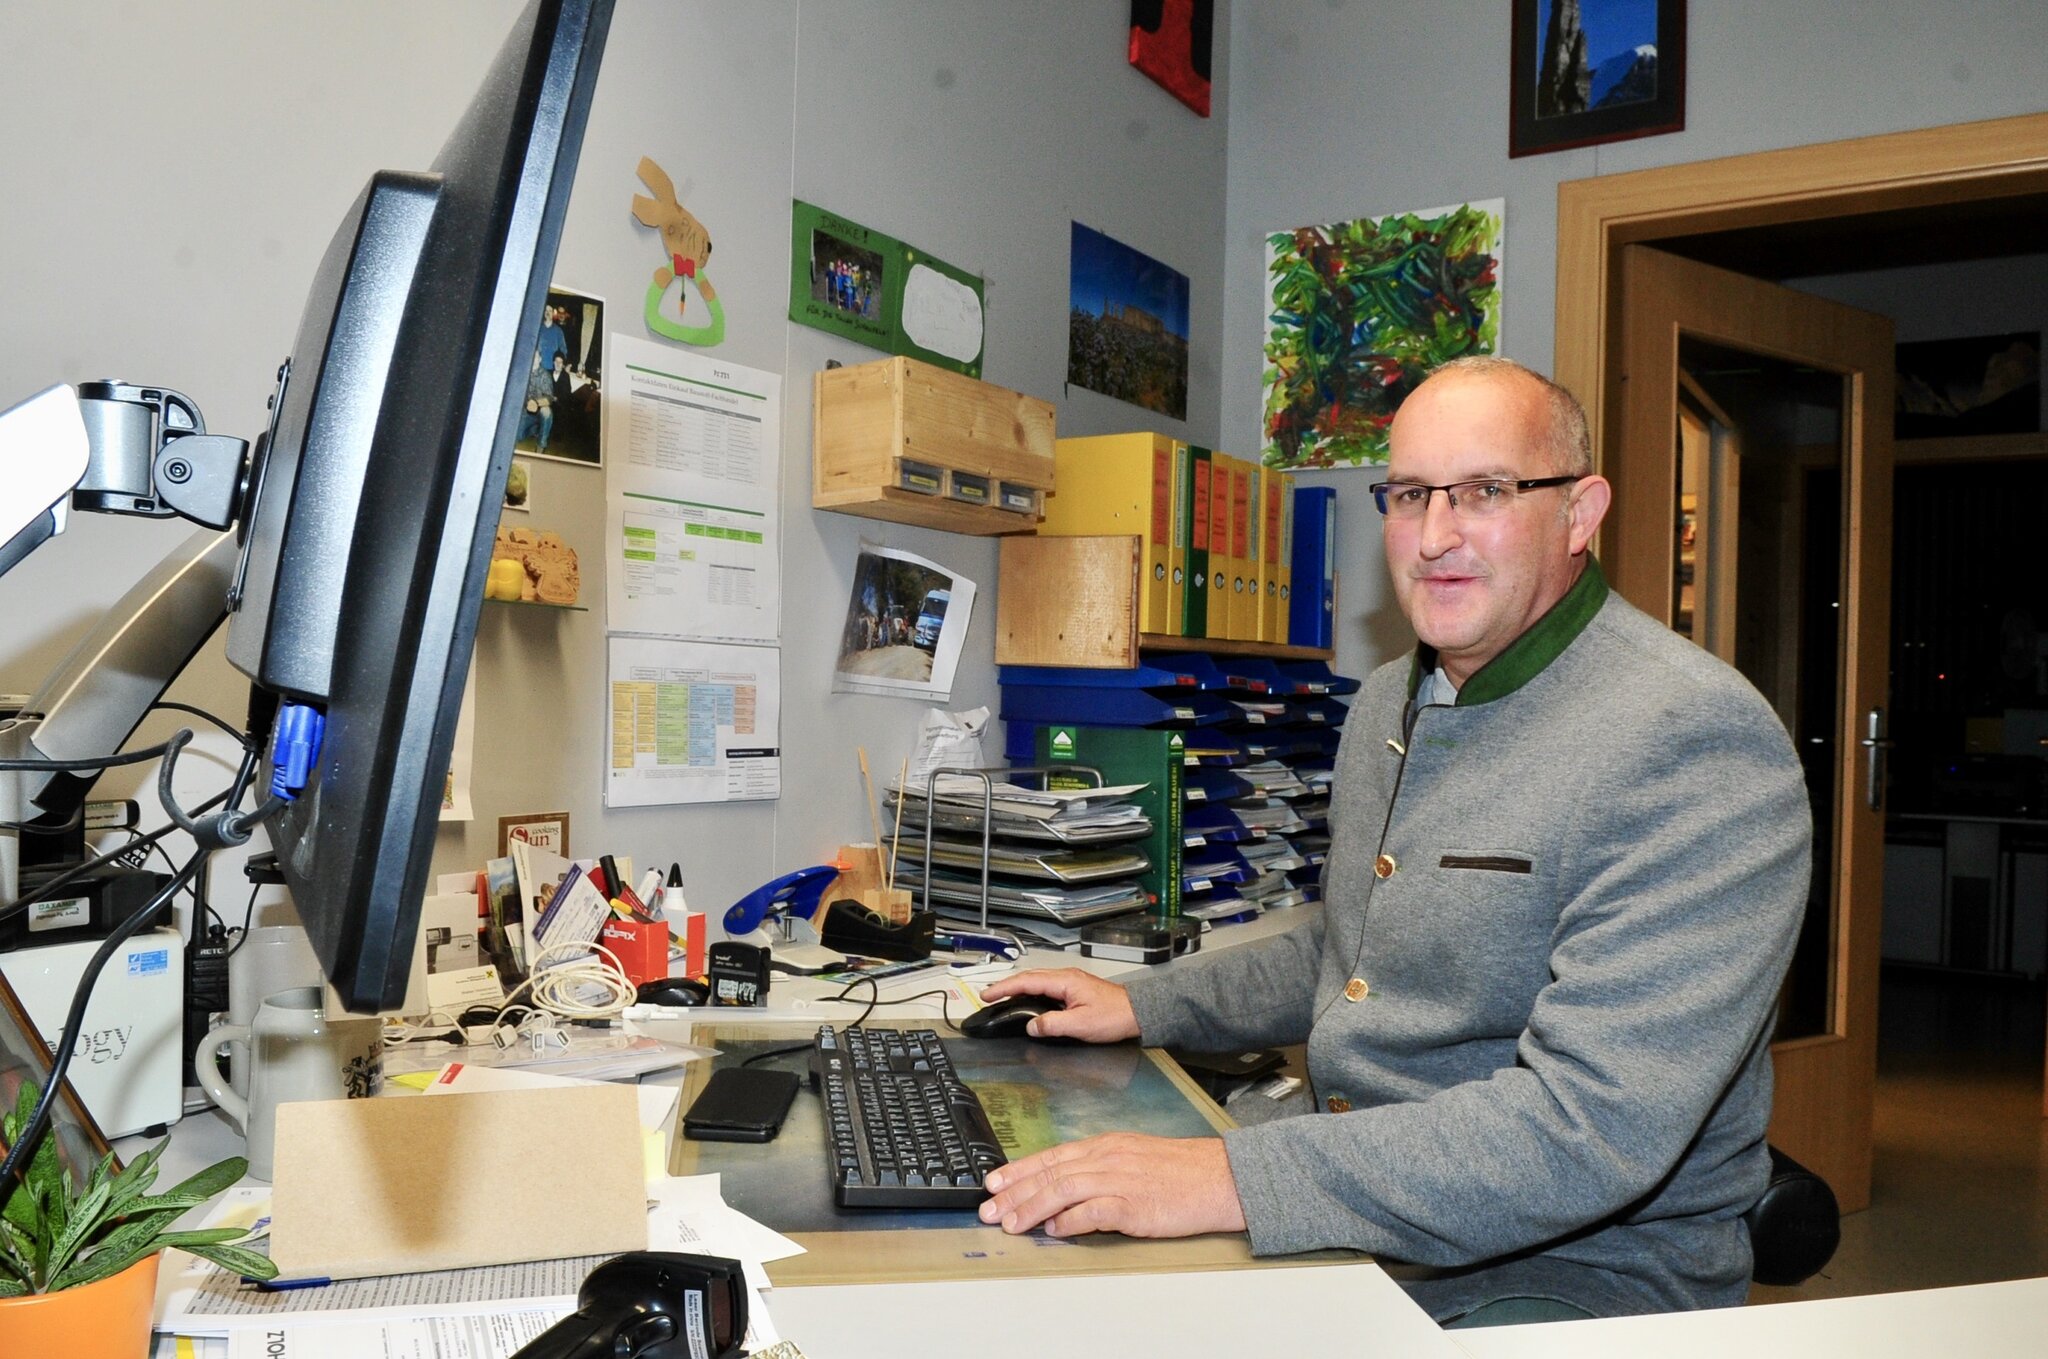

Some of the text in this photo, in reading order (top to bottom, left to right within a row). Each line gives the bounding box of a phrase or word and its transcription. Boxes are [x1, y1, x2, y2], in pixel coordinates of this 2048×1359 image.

[531, 825, 560, 837] cooking
[1169, 859, 1177, 879] AUF
[1169, 880, 1177, 917] BESSER
